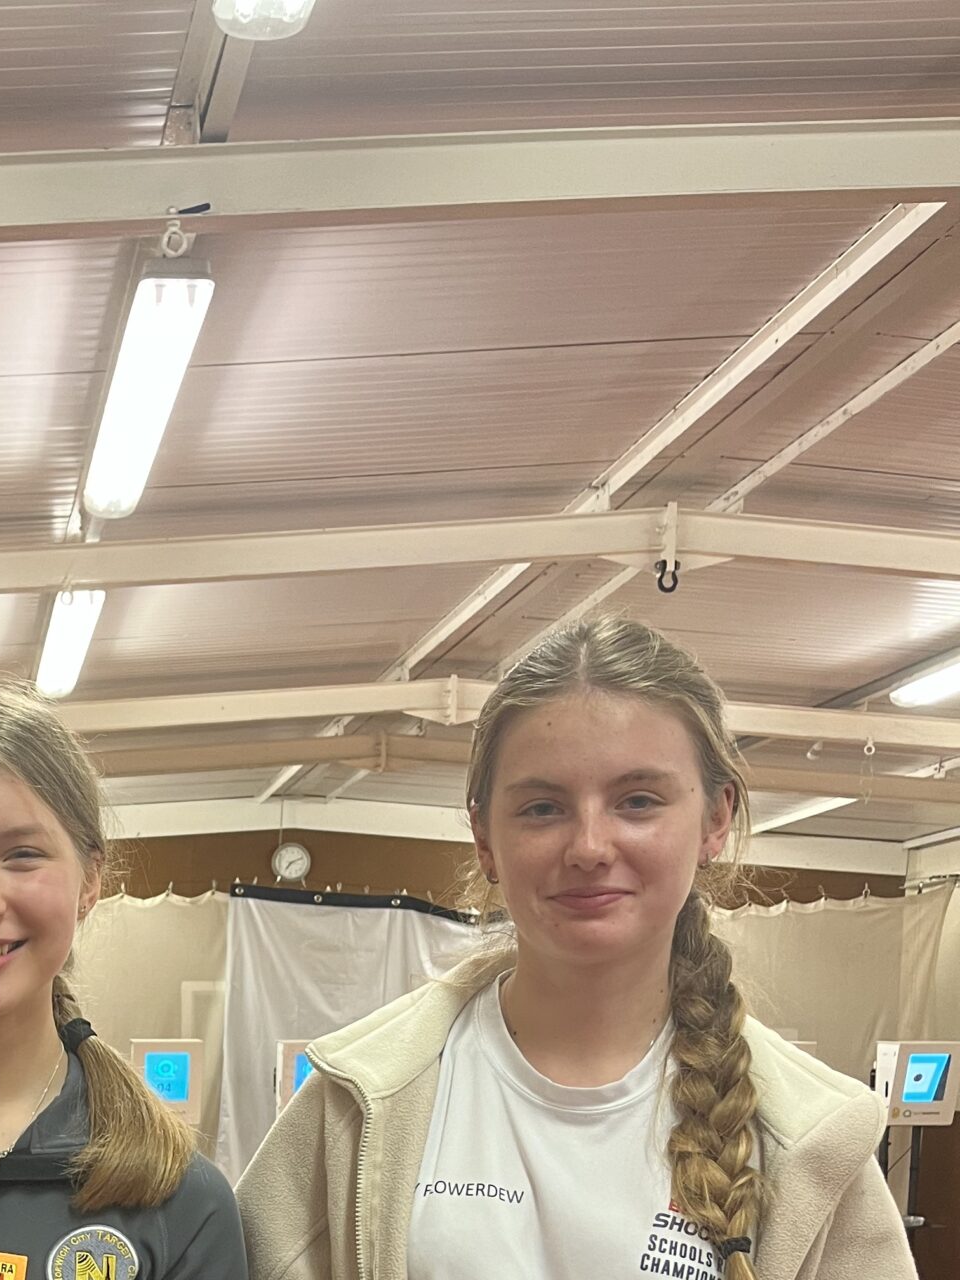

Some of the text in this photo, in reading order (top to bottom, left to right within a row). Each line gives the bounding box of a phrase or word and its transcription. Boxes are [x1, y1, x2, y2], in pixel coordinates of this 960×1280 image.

[423, 1180, 525, 1204] FOWERDEW
[652, 1212, 711, 1241] SHOO
[97, 1230, 132, 1260] TARGET
[647, 1233, 714, 1268] SCHOOLS
[0, 1263, 14, 1274] RA
